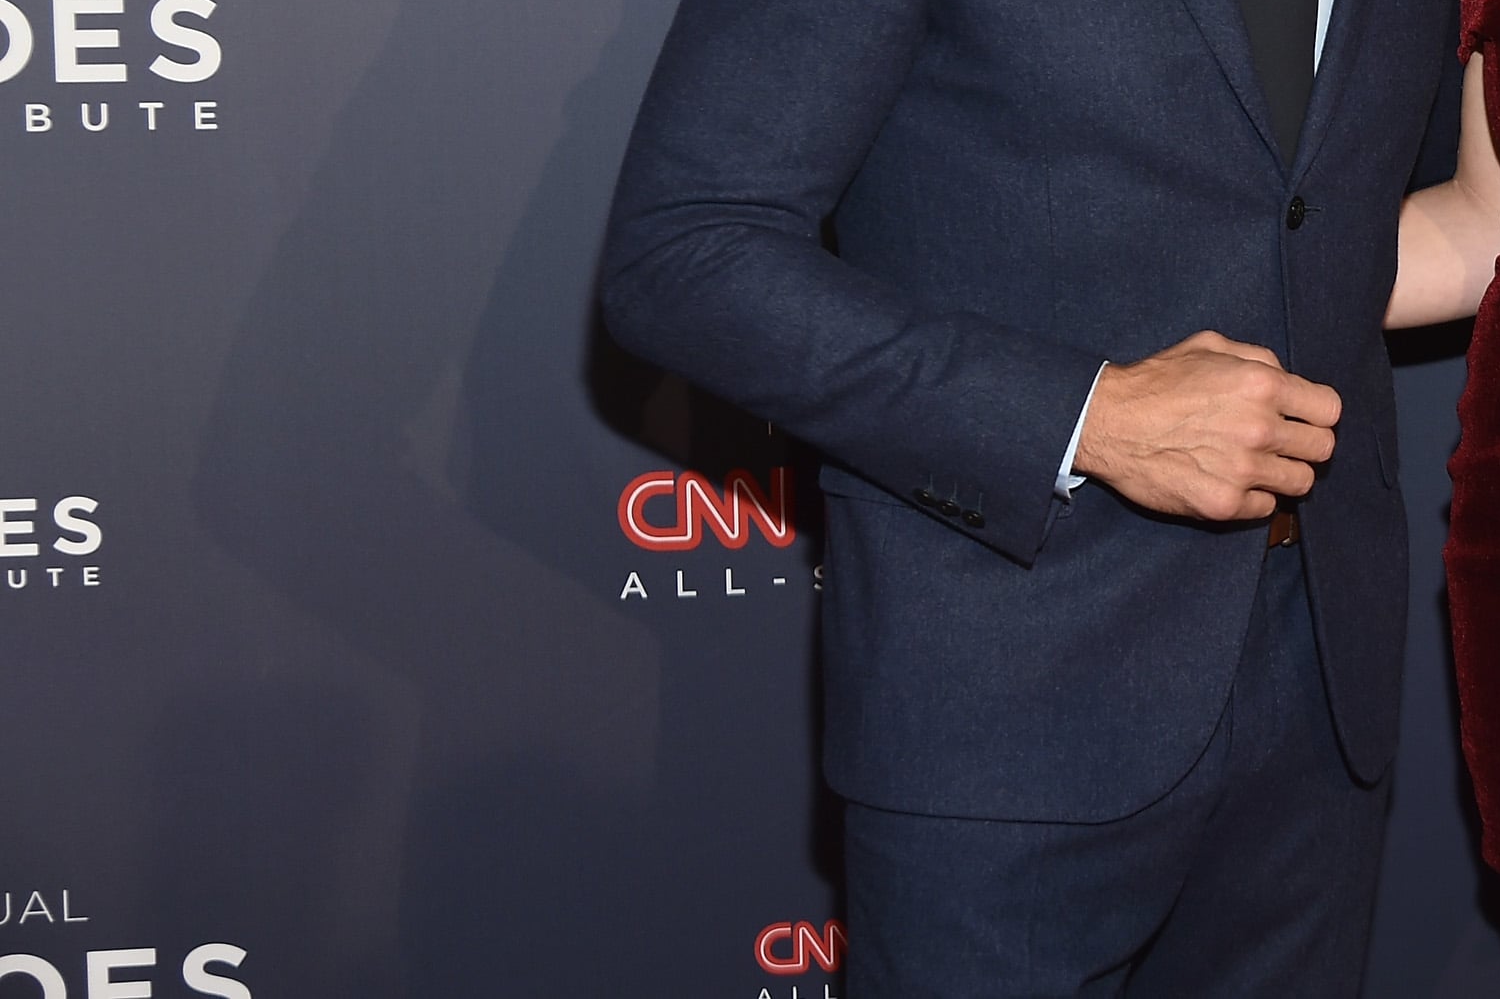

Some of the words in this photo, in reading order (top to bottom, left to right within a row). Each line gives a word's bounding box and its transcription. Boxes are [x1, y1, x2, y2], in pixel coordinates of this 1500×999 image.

[25, 102, 218, 132] BUTE
[617, 467, 796, 552] CNN
[621, 565, 823, 599] ALL-
